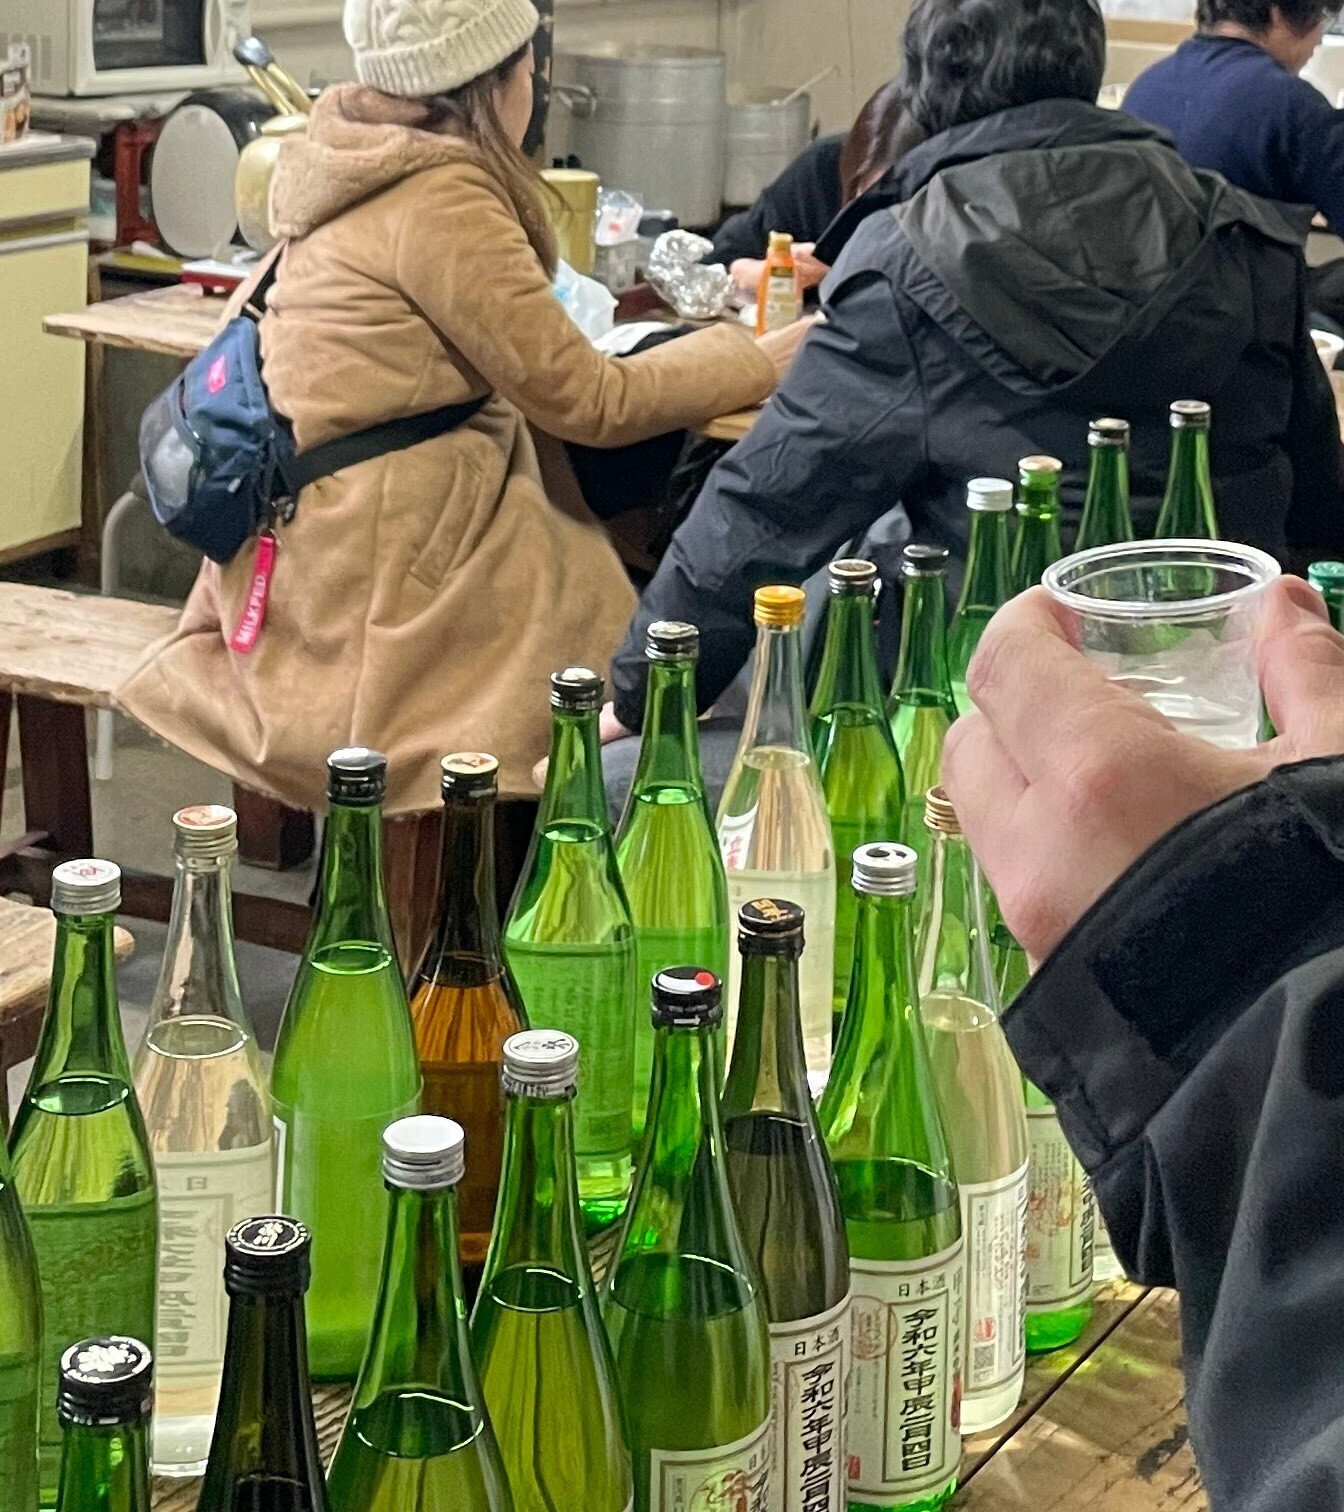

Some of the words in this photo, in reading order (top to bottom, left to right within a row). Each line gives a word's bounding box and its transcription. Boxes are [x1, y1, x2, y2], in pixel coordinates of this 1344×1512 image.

[898, 1272, 946, 1298] 日本酒
[794, 1326, 840, 1356] 日本酒
[899, 1308, 940, 1472] 令和六年甲辰二月四日
